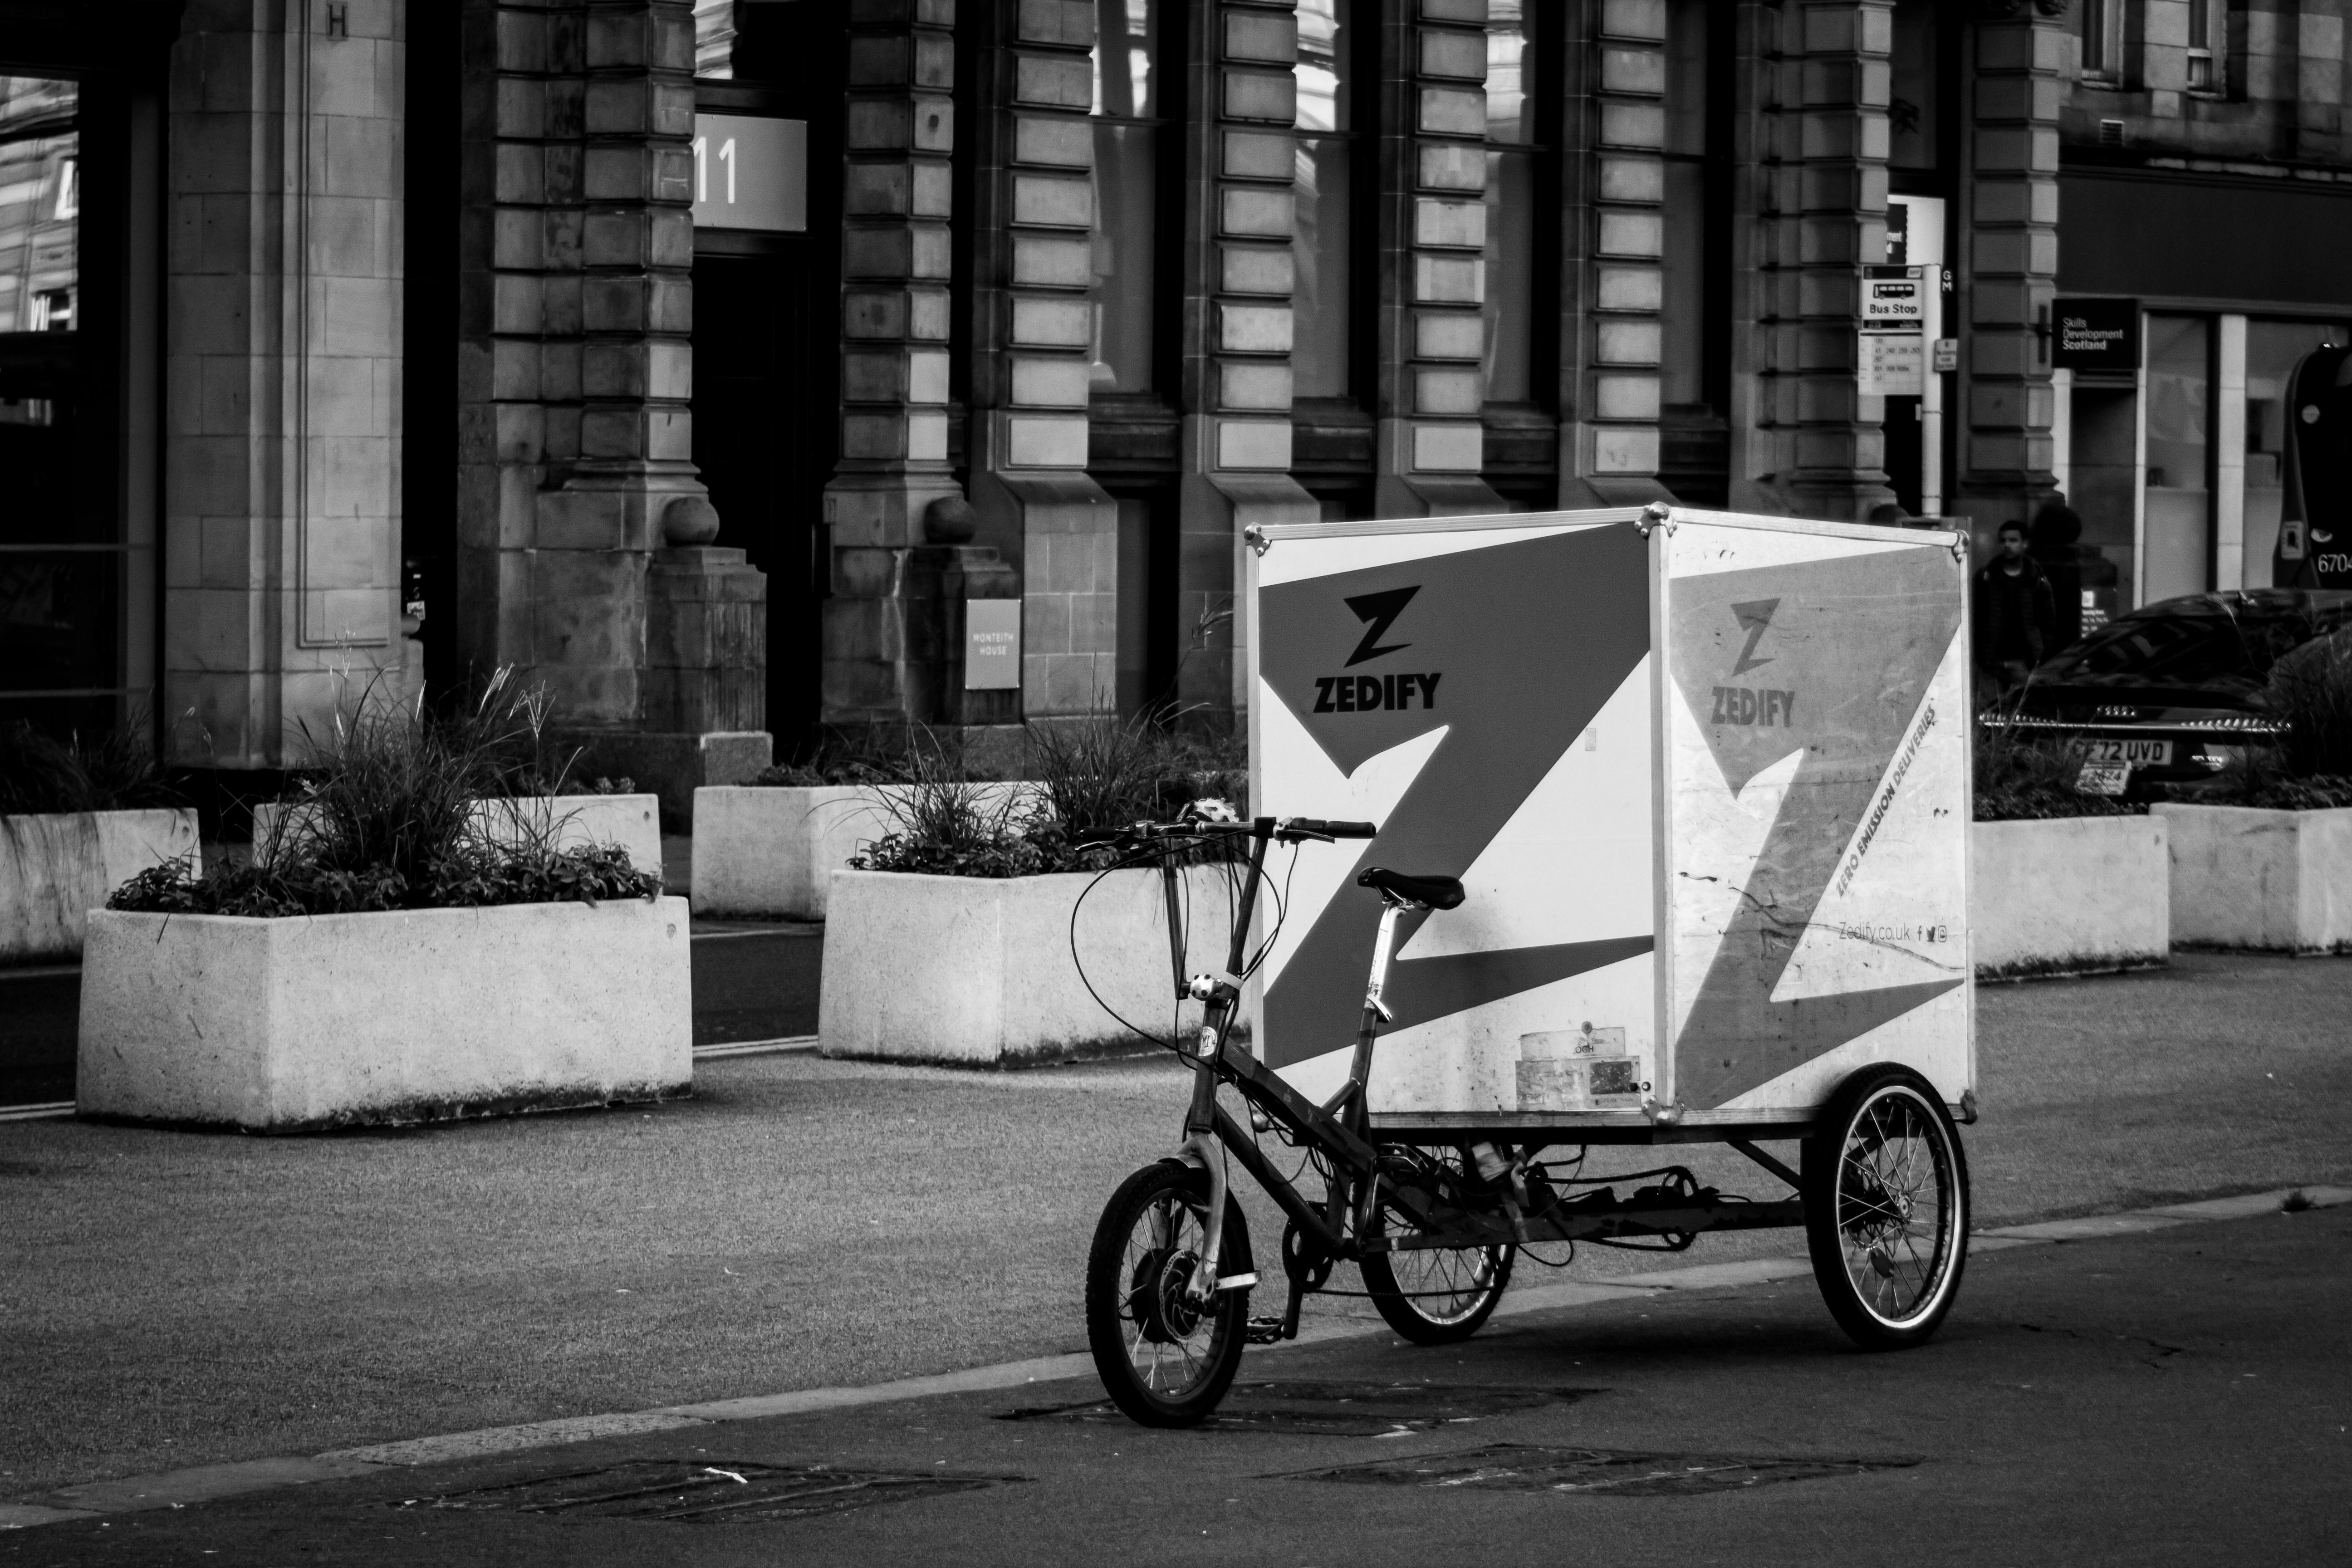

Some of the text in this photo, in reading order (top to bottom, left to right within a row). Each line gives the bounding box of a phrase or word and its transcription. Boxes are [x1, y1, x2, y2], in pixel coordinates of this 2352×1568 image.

[693, 137, 735, 204] 11
[1870, 304, 1917, 314] Bus Stop
[2063, 317, 2087, 328] Skills
[2063, 328, 2123, 340] Development
[2063, 339, 2107, 350] Scotland
[973, 633, 1014, 643] MONTEITH
[980, 646, 1007, 655] HOUSE
[1313, 672, 1442, 713] ZEDIFY
[1710, 686, 1795, 727] ZEDIFY
[2126, 742, 2163, 761] UVD
[1836, 704, 1935, 899] ZERO EMISSION DELIVERIES
[1838, 921, 1911, 943] Zedify.co.uk
